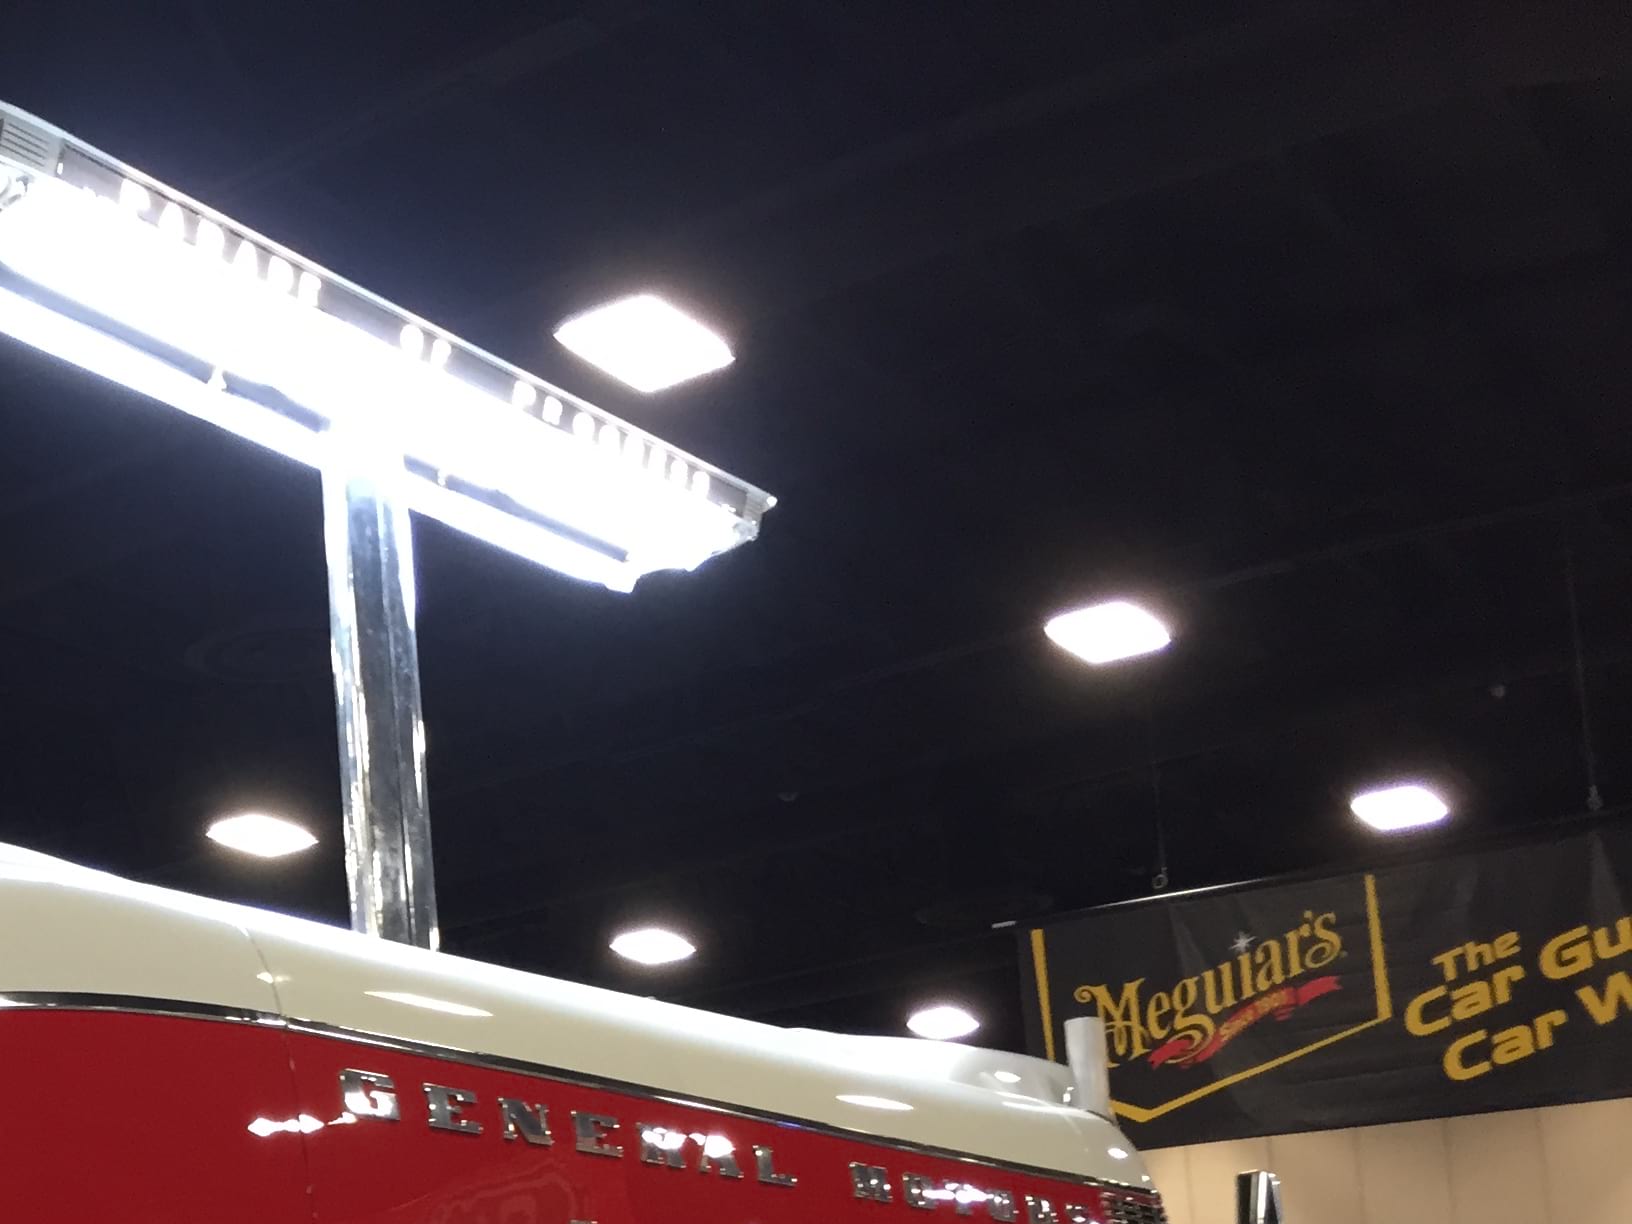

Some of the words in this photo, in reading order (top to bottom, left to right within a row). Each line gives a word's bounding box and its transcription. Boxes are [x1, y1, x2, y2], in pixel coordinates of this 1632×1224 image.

[1073, 910, 1344, 1068] Meguiar's
[1430, 931, 1522, 982] The
[1404, 965, 1525, 1037] Car
[1442, 1009, 1568, 1081] Car
